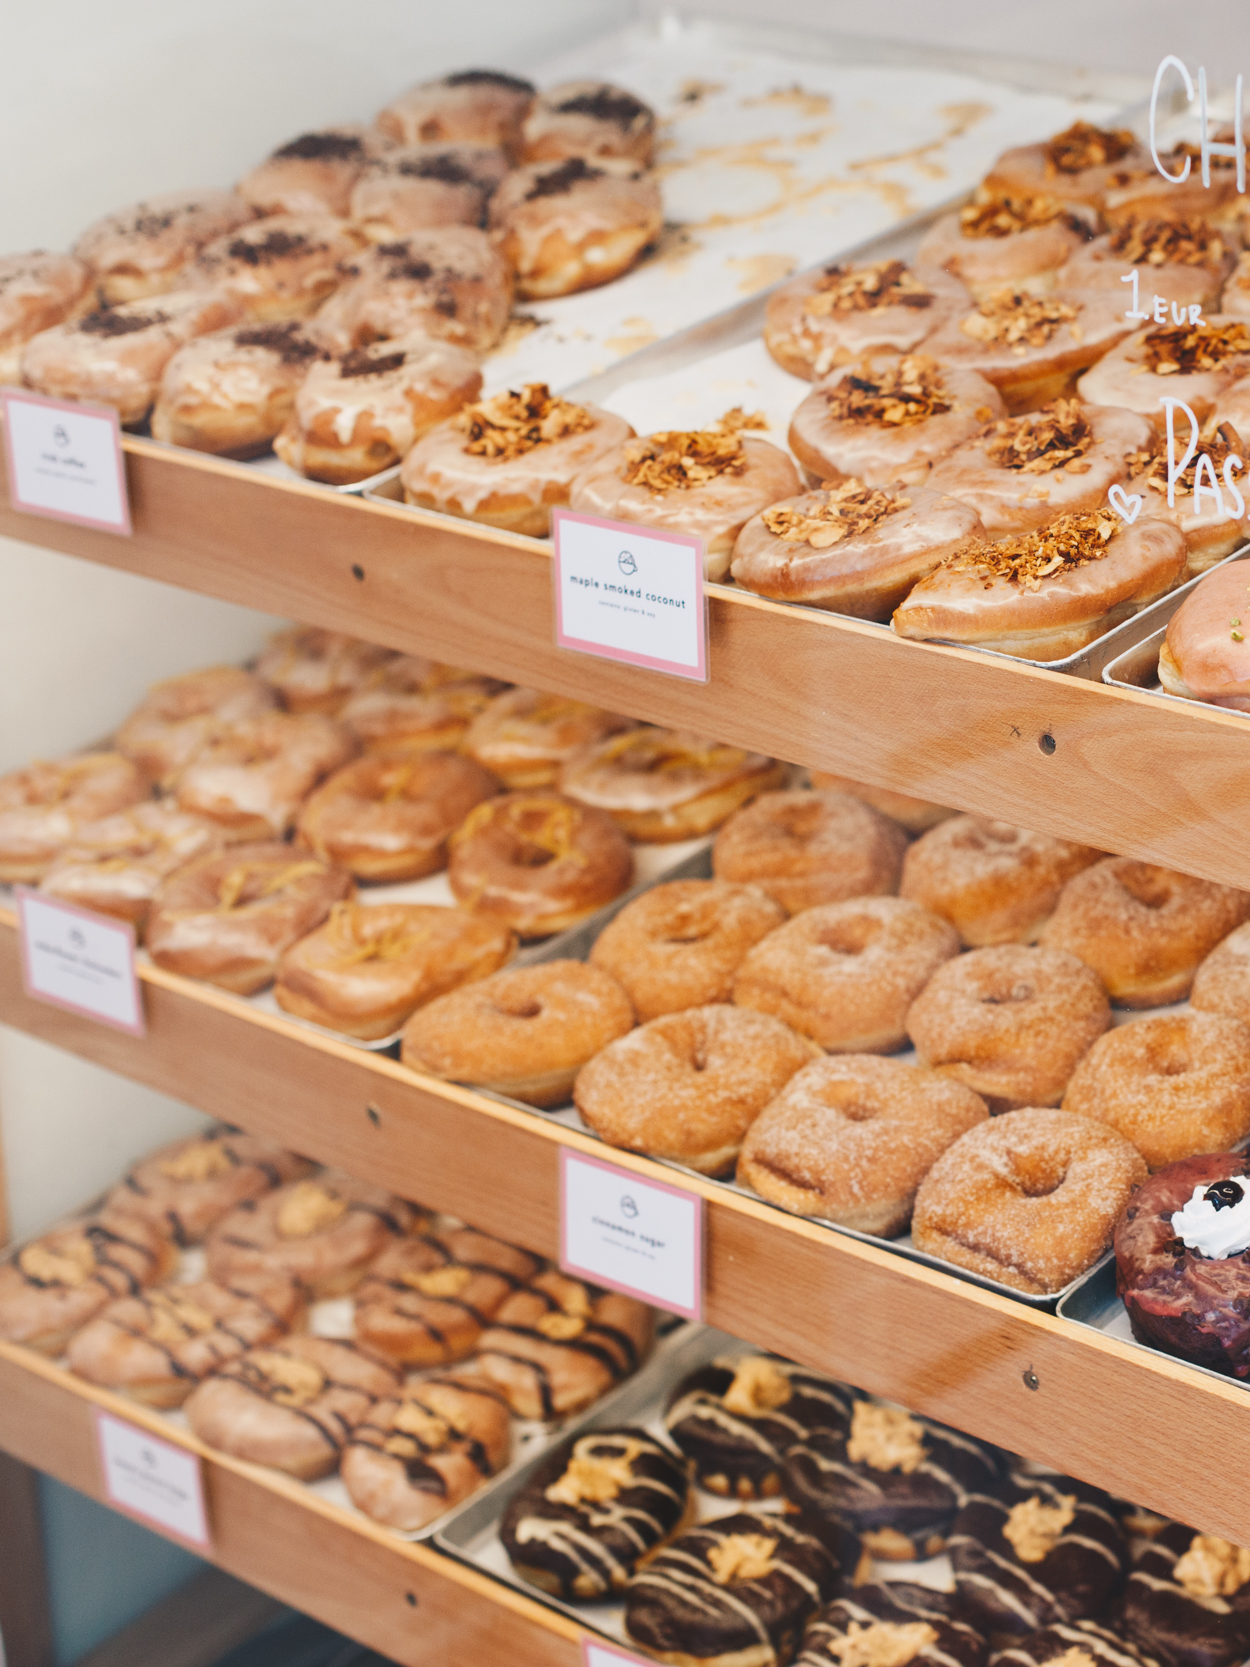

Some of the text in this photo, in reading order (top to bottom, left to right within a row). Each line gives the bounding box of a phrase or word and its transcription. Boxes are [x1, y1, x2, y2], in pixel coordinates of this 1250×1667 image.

[570, 575, 686, 609] maple smoked coconut
